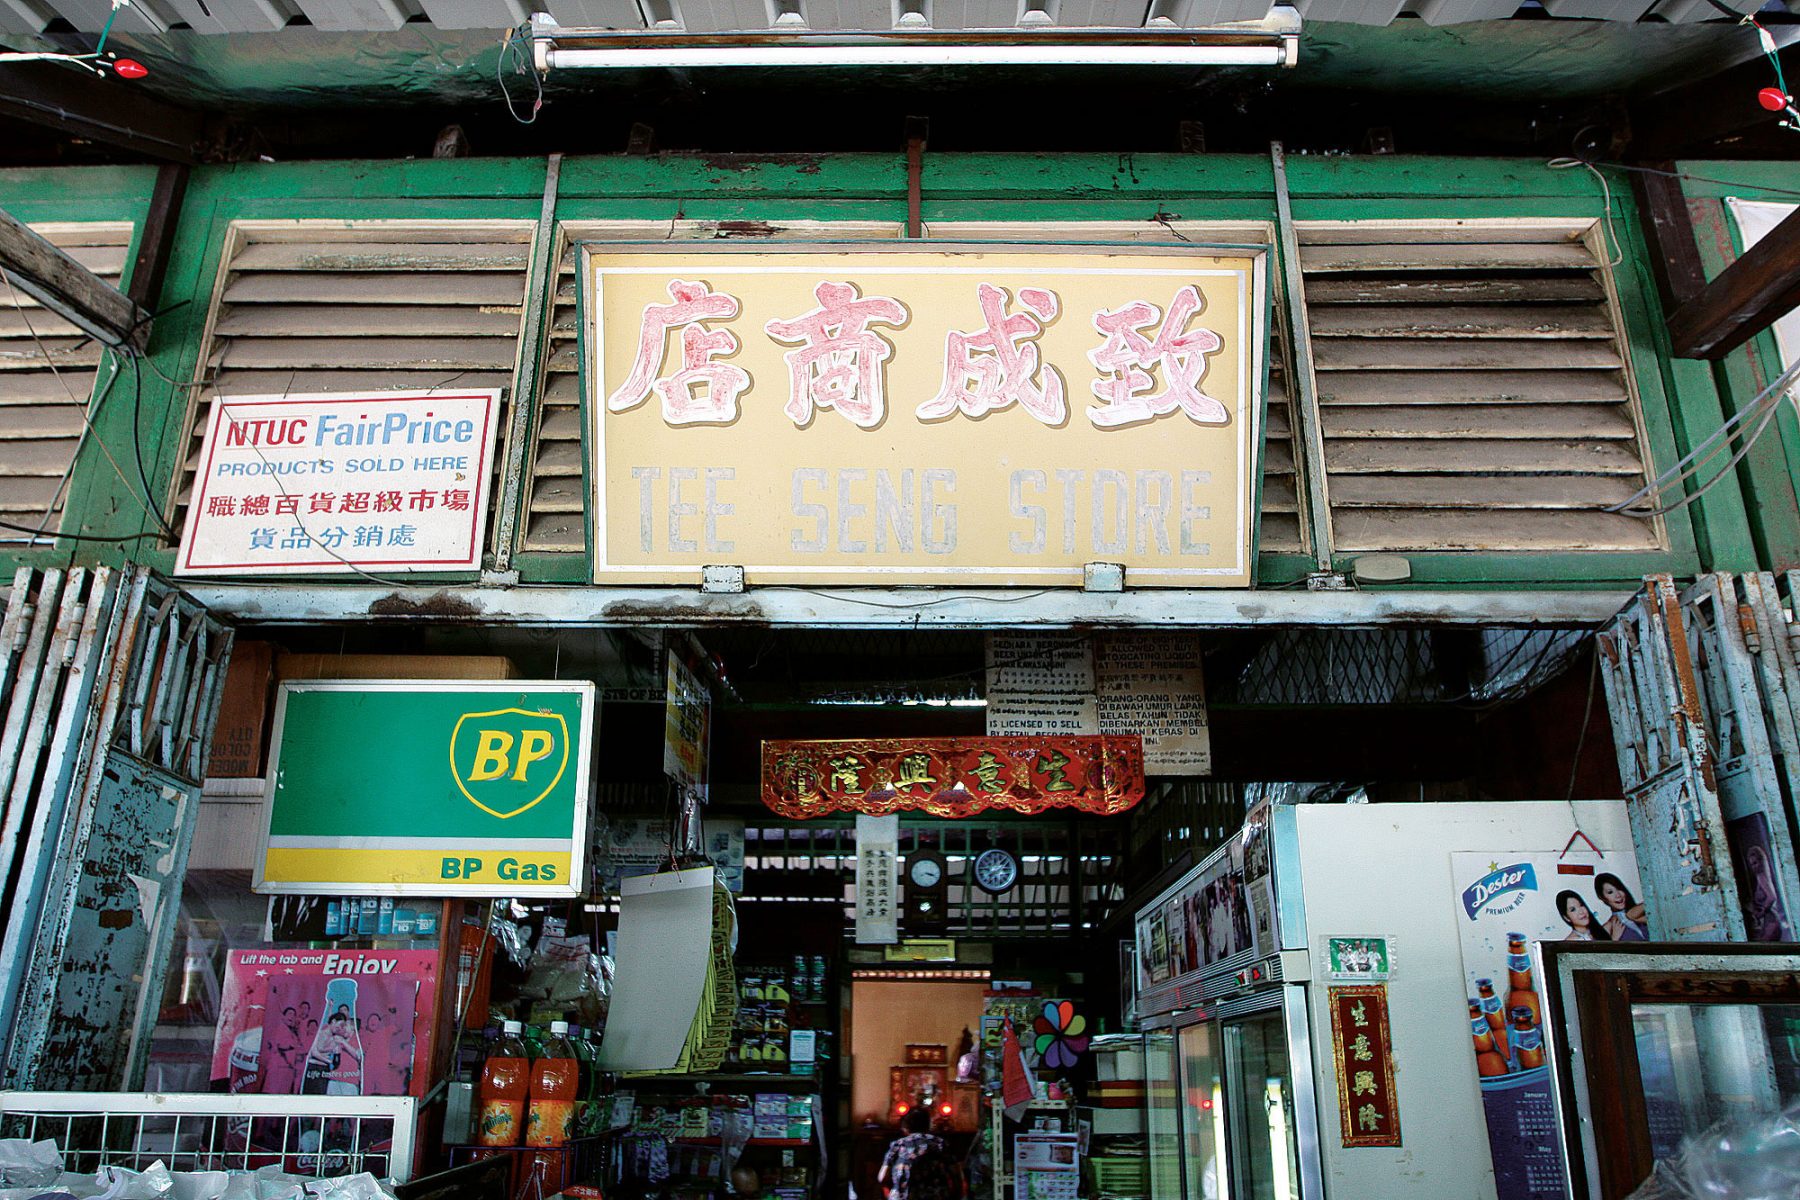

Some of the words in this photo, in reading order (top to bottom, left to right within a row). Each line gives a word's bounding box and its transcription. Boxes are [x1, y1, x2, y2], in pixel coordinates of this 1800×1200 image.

[225, 418, 307, 447] NTUC
[315, 411, 474, 447] FairPrice
[217, 459, 334, 477] PRODUCTS
[345, 457, 404, 474] SOLD
[413, 455, 468, 472] HERE
[631, 466, 735, 554] TEE
[791, 467, 958, 555] SENG
[1009, 469, 1211, 556] STORE
[249, 525, 417, 551] 貨品分銷處
[1160, 644, 1170, 652] TO
[1100, 694, 1169, 702] ORANG-ORANG
[1175, 694, 1201, 702] YANG
[1099, 703, 1108, 711] DI
[1109, 703, 1144, 711] BAWAH
[1145, 703, 1172, 711] UMUR
[1174, 702, 1205, 711] LAPAN
[1100, 711, 1130, 719] BELAS
[1136, 711, 1168, 719] TAHUN
[1174, 711, 1201, 719] TIDAK
[989, 720, 998, 728] IS
[1001, 720, 1043, 728] LICENSED
[1046, 720, 1057, 728] TO
[1060, 720, 1083, 728] SELL
[1099, 720, 1160, 728] DIBENARKAN
[1166, 719, 1208, 727] MEMBELI
[1100, 728, 1146, 736] MINUMAN
[1151, 728, 1183, 736] KERAS
[1189, 728, 1199, 736] DI
[467, 730, 554, 783] BP
[441, 857, 482, 880] BP
[496, 857, 557, 881] Gas
[1471, 869, 1527, 909] Dester
[1485, 903, 1515, 916] PREMIUM
[240, 954, 258, 965] Lift
[258, 954, 276, 965] the
[279, 954, 298, 965] tab
[300, 954, 324, 965] and
[306, 1070, 321, 1079] Life
[342, 1070, 360, 1080] good
